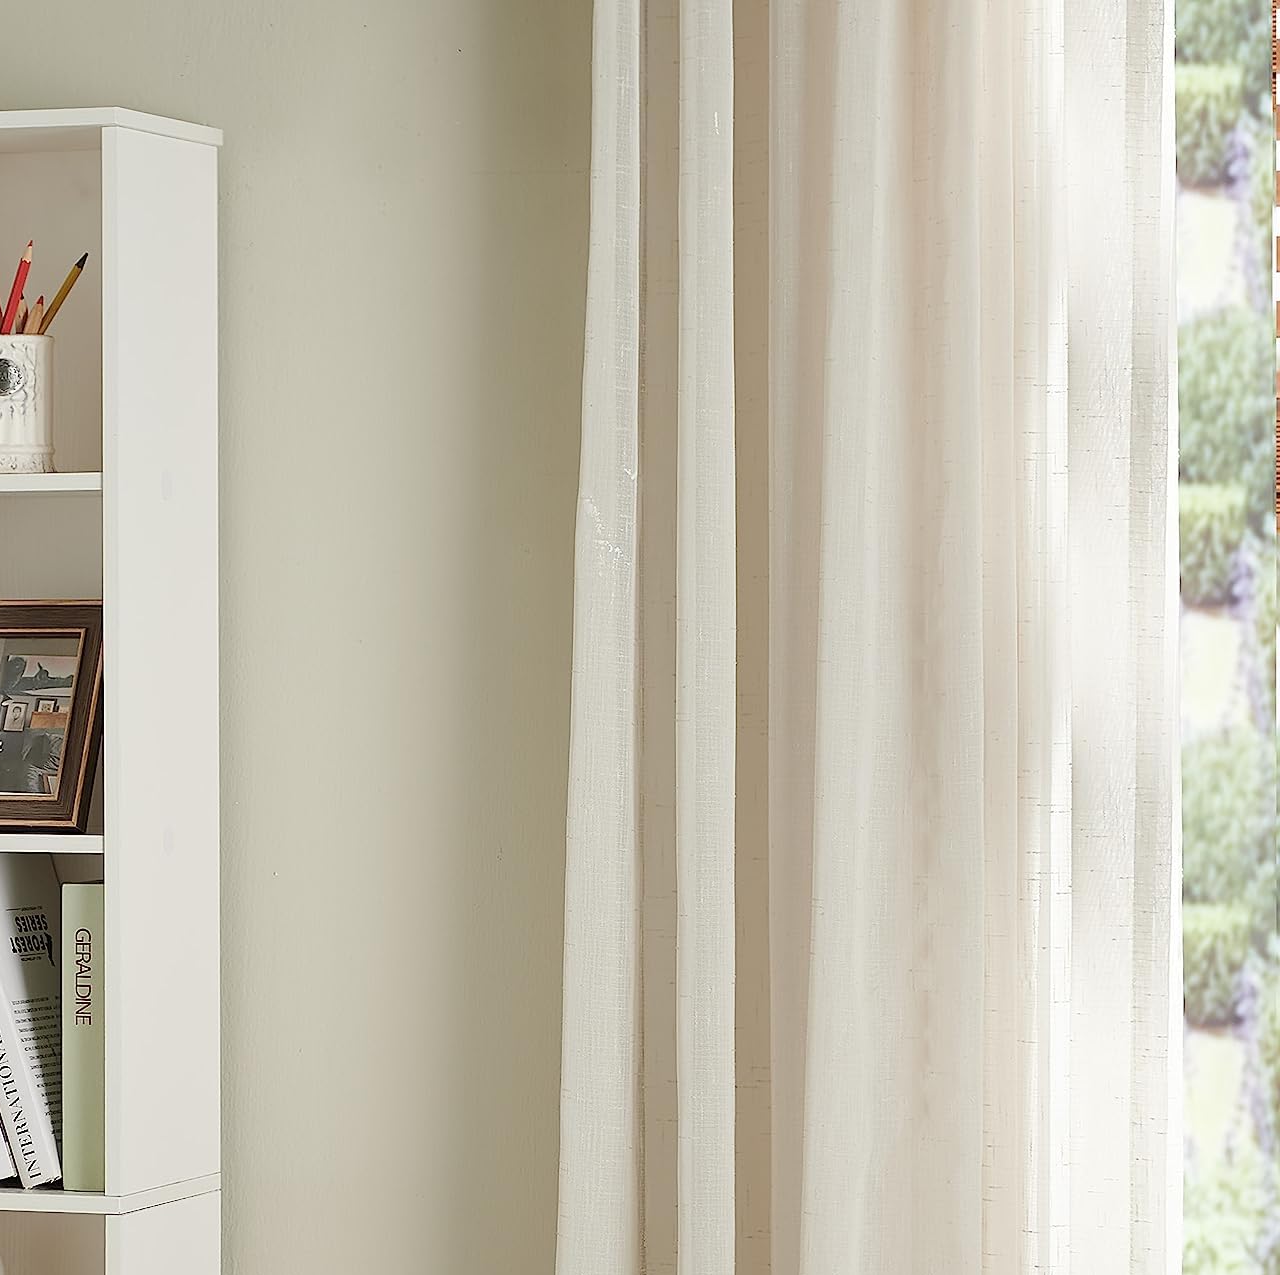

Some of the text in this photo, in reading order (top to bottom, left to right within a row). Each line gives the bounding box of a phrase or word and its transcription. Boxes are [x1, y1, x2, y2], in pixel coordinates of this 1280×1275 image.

[14, 913, 48, 933] SERIES
[9, 935, 47, 954] FOREST
[75, 928, 92, 1026] GERALDINE
